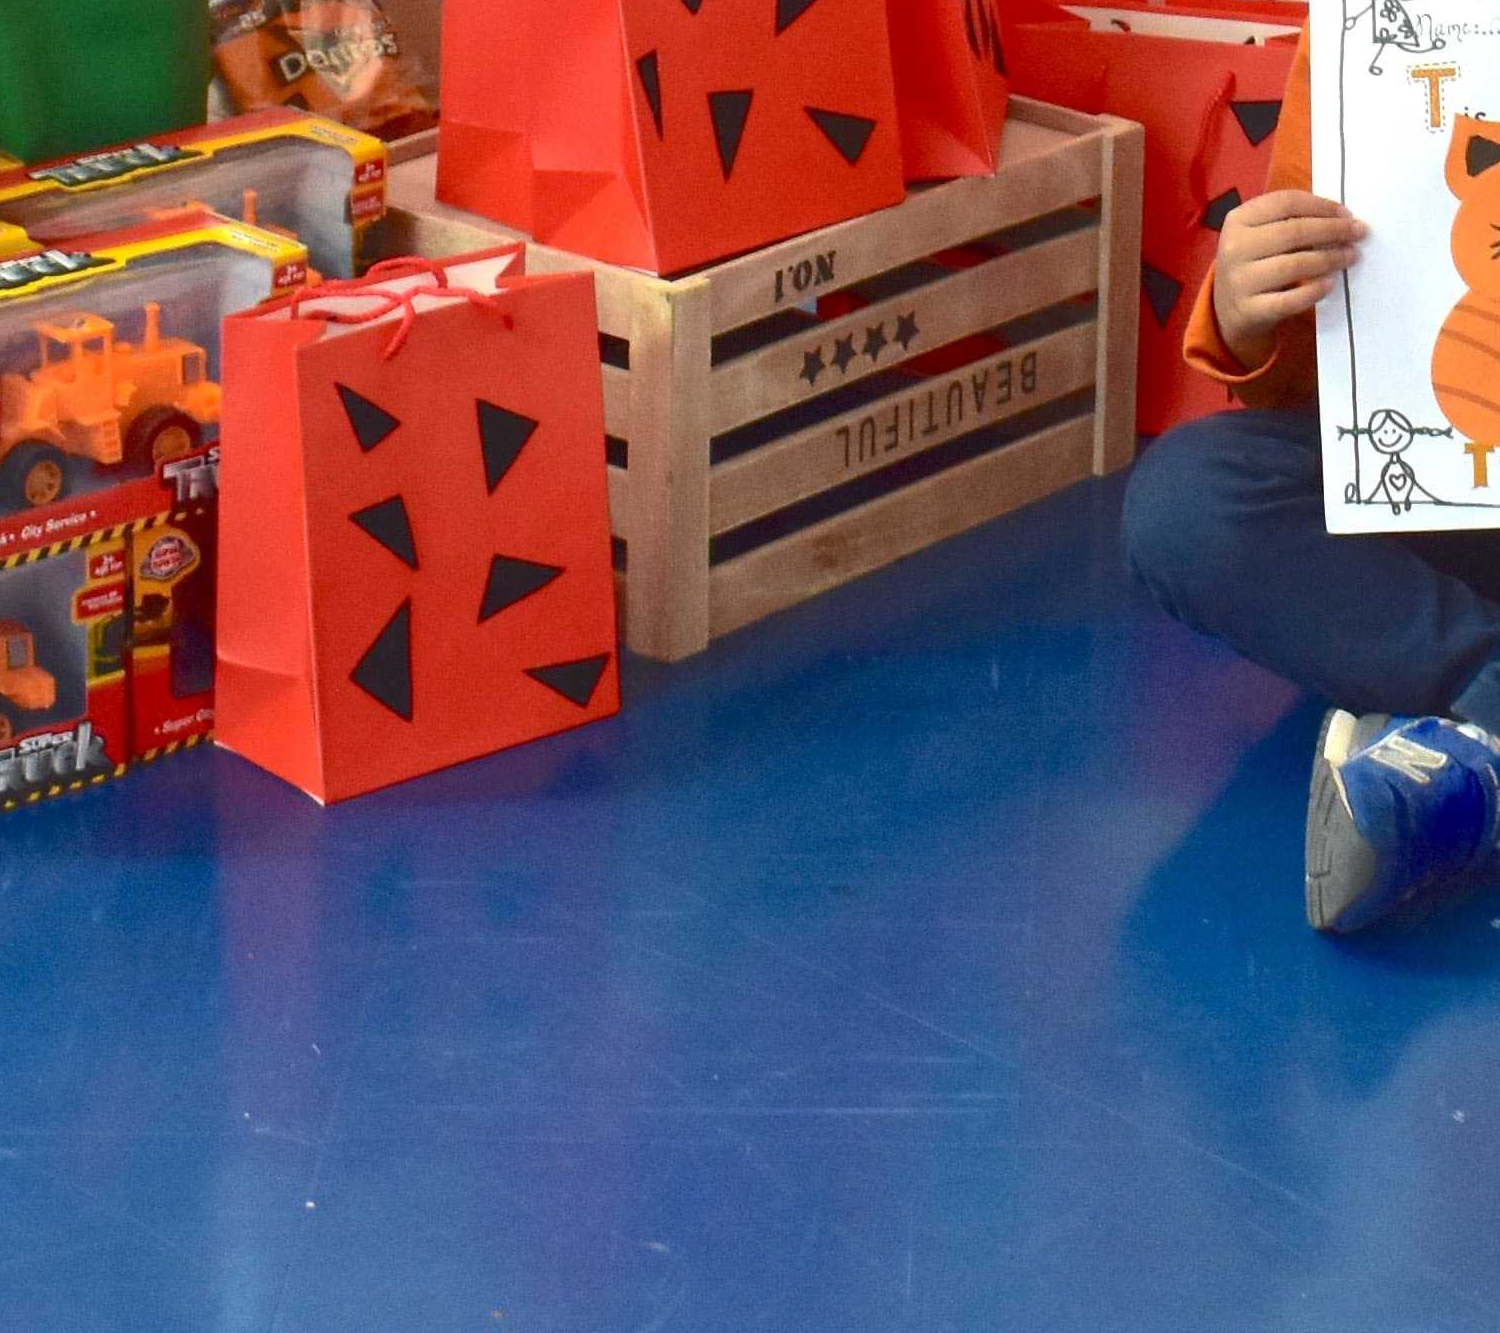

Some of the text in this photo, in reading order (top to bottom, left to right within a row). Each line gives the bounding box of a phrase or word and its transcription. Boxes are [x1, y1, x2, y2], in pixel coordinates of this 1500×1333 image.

[1409, 65, 1458, 130] T
[774, 251, 837, 304] NO.1
[837, 351, 1038, 468] BEAUTIFUL
[21, 523, 44, 540] City
[46, 512, 88, 532] Service
